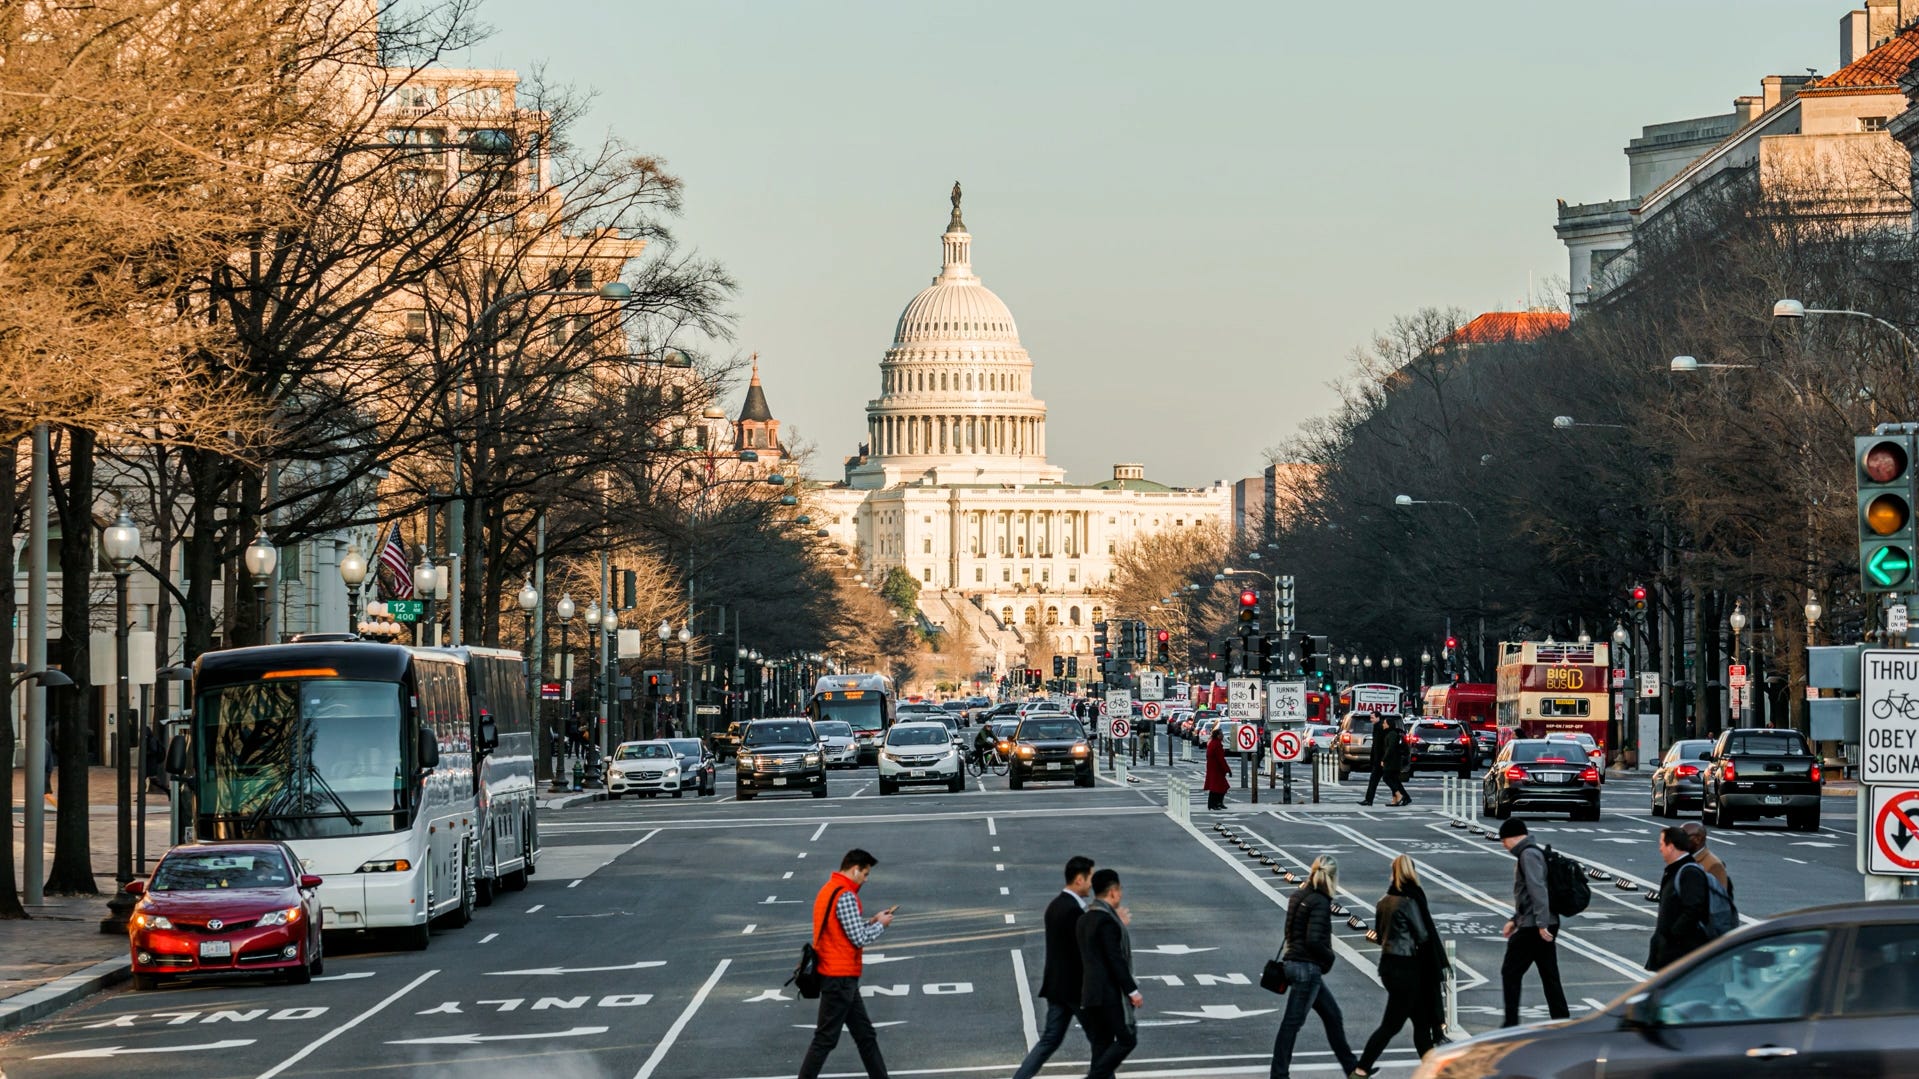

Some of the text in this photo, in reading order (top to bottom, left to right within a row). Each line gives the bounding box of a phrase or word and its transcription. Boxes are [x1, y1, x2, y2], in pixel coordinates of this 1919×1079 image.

[394, 603, 406, 612] 12
[1547, 668, 1567, 679] BIG
[1870, 660, 1918, 680] THRU
[1547, 679, 1567, 689] BUS
[824, 691, 833, 701] 33
[1357, 702, 1397, 713] MARTZ
[1869, 729, 1917, 748] OBEY
[742, 982, 974, 1003] ONY
[414, 993, 654, 1015] ONLY
[82, 1006, 330, 1029] ONLY
